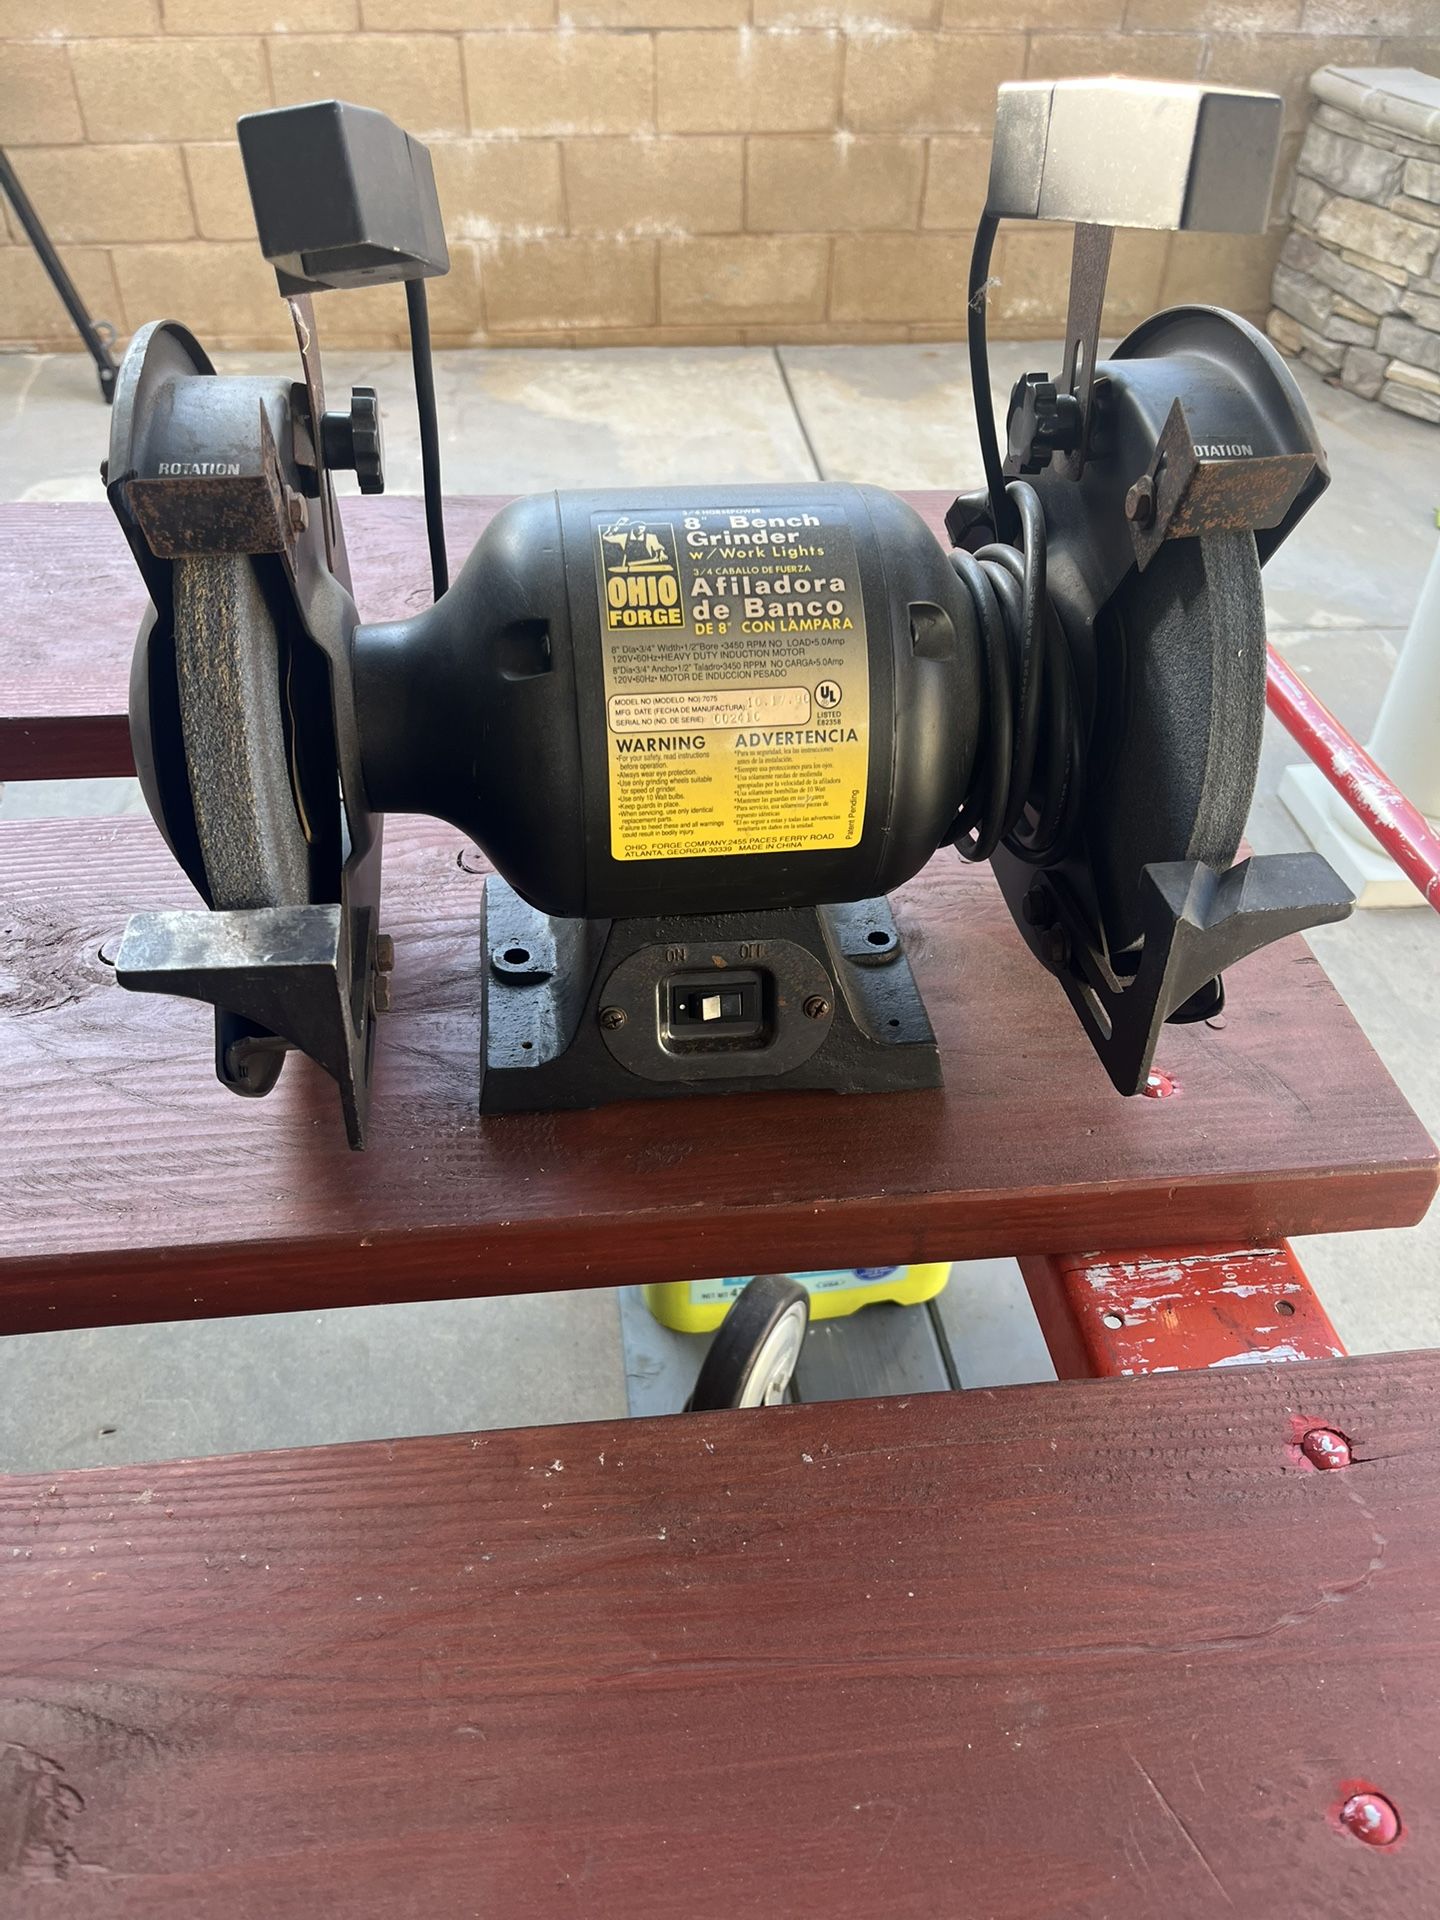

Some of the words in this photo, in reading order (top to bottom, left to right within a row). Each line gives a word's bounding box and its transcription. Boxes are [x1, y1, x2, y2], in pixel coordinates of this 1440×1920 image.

[1194, 444, 1253, 457] OTATION
[158, 462, 240, 475] ROTATION
[702, 508, 761, 516] HORSEPOWER
[684, 516, 706, 530] 8"
[729, 514, 820, 528] Bench
[687, 530, 799, 546] Grinder
[773, 545, 825, 559] Lights
[693, 568, 712, 576] 3/4
[716, 566, 759, 575] CABALLO
[762, 566, 773, 574] DE
[776, 565, 812, 574] FUERZA
[608, 575, 678, 608] OHIO
[691, 575, 845, 597] Afiladora
[692, 600, 730, 620] de
[744, 598, 844, 618] Banco
[609, 608, 681, 626] FORGE
[695, 622, 714, 635] DE
[718, 622, 732, 634] 8"
[742, 620, 776, 633] CON
[611, 645, 620, 654] 8"
[747, 640, 766, 648] RPM
[769, 640, 782, 648] NO
[694, 652, 718, 660] DUTY
[721, 649, 770, 659] INDUCTION
[772, 648, 806, 657] MOTOR
[744, 660, 766, 669] RPPM
[770, 660, 784, 668] NO
[660, 673, 690, 682] MOTOR
[692, 672, 703, 680] DE
[706, 671, 752, 680] INDUCCION
[754, 669, 787, 678] PESADO
[653, 697, 684, 705] (MODELO
[820, 686, 836, 702] UL
[654, 706, 679, 715] (FECHA
[616, 736, 706, 752] WARNING
[736, 728, 858, 748] ADVERTENCIA
[646, 778, 668, 786] grinding
[670, 776, 690, 784] wheels
[630, 786, 648, 794] speed
[637, 802, 656, 810] guards
[691, 806, 714, 814] identical
[848, 788, 860, 819] Pending
[700, 820, 724, 828] warnings
[846, 819, 856, 840] Patent
[625, 844, 648, 852] OHIO
[652, 842, 682, 850] FORGE
[749, 836, 777, 844] PACES
[780, 834, 808, 842] FERRY
[810, 833, 835, 841] ROAD
[625, 850, 664, 858] ATLANTA,
[667, 847, 707, 856] GEORGIA
[776, 842, 803, 850] CHINA
[666, 948, 686, 962] ON
